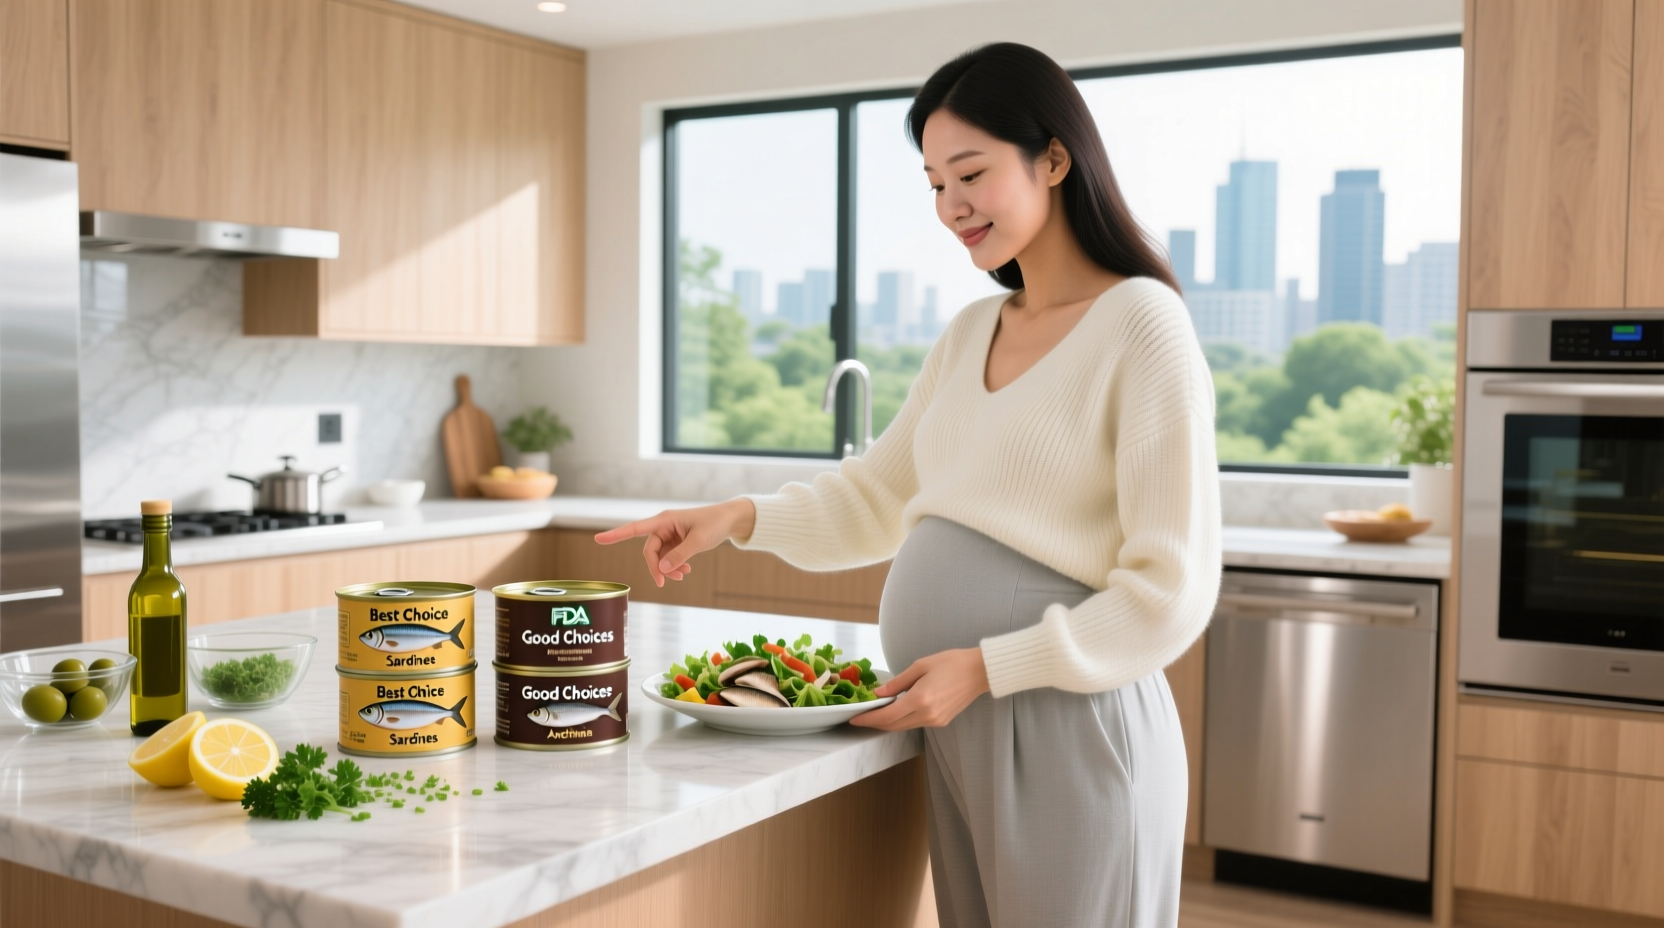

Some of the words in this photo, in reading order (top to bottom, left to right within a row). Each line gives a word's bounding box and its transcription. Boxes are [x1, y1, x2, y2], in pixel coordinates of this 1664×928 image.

[369, 607, 400, 622] Best
[402, 606, 449, 621] Choice
[551, 605, 590, 626] FDA
[521, 629, 560, 645] Good
[563, 629, 614, 645] Choices
[376, 685, 405, 699] Best
[521, 685, 560, 701] Good
